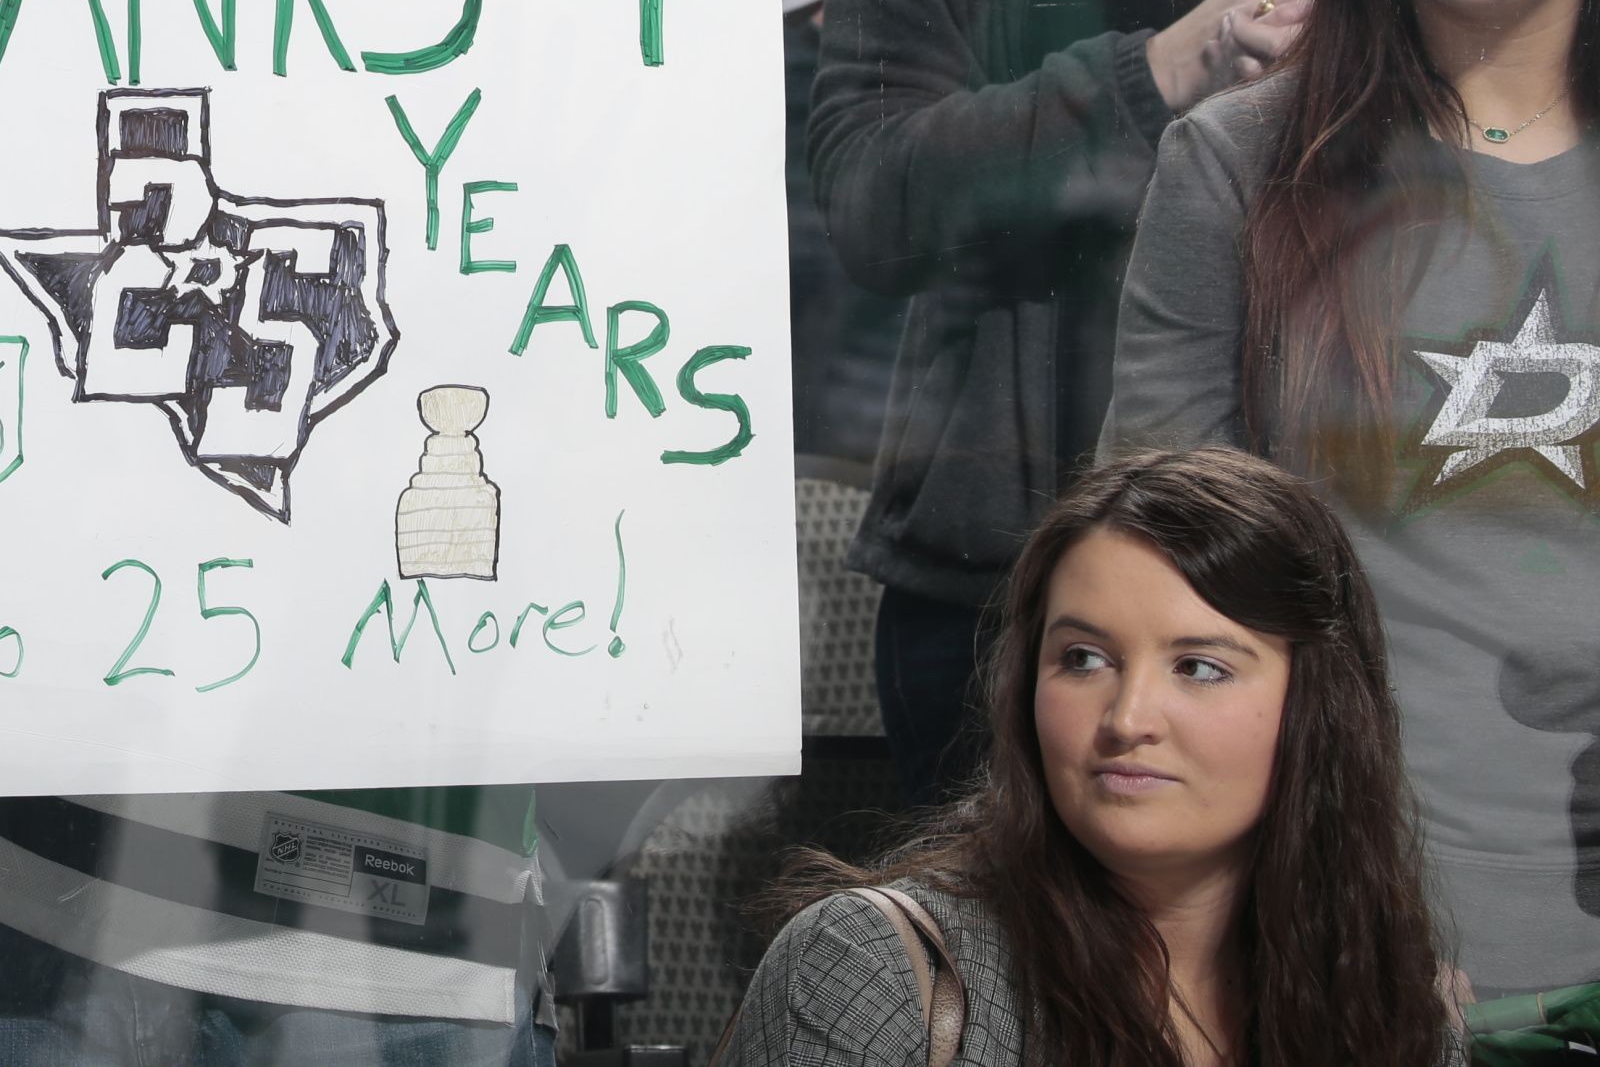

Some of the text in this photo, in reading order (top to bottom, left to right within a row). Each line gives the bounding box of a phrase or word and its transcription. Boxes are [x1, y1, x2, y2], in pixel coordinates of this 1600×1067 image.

[384, 87, 757, 466] YEARS
[101, 557, 261, 692] 25
[341, 508, 627, 676] More!
[364, 853, 415, 876] Reebok
[367, 879, 406, 907] XL
